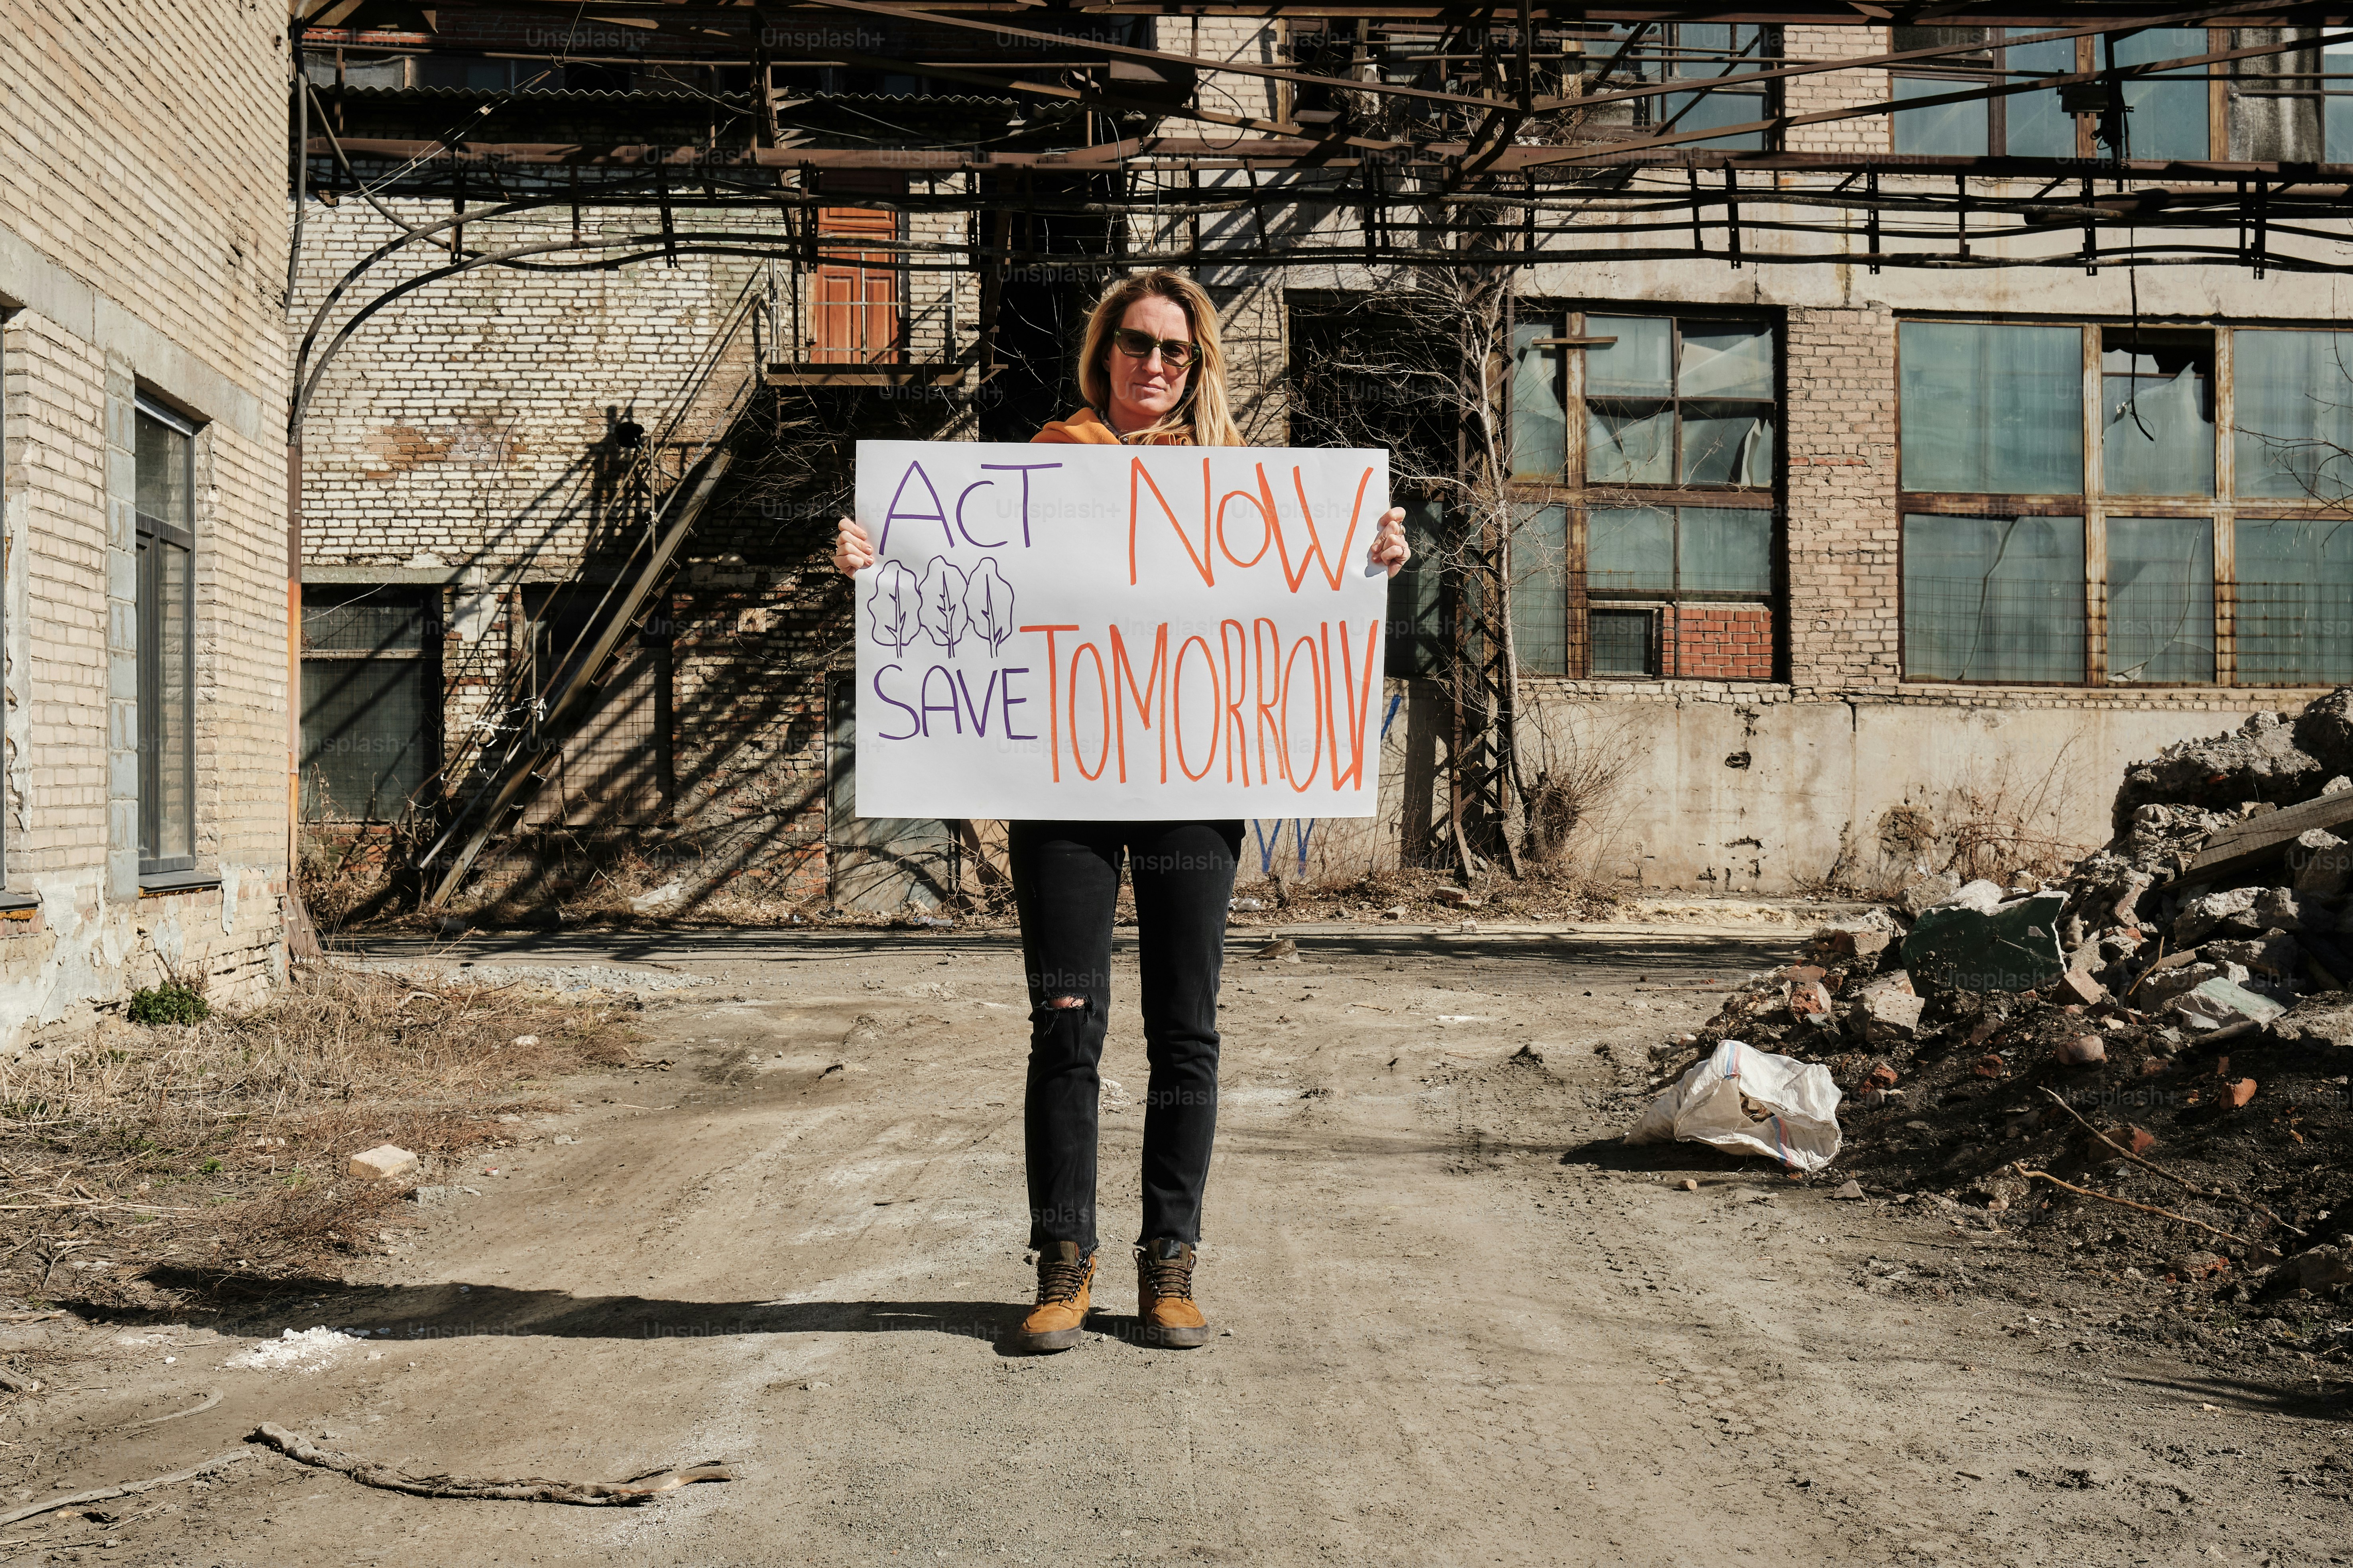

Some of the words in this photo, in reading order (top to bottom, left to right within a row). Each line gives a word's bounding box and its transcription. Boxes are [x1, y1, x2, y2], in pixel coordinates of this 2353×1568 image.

[879, 460, 1063, 556] ACT
[874, 665, 1037, 740] SAVE
[1019, 617, 1379, 793] TOMORROW
